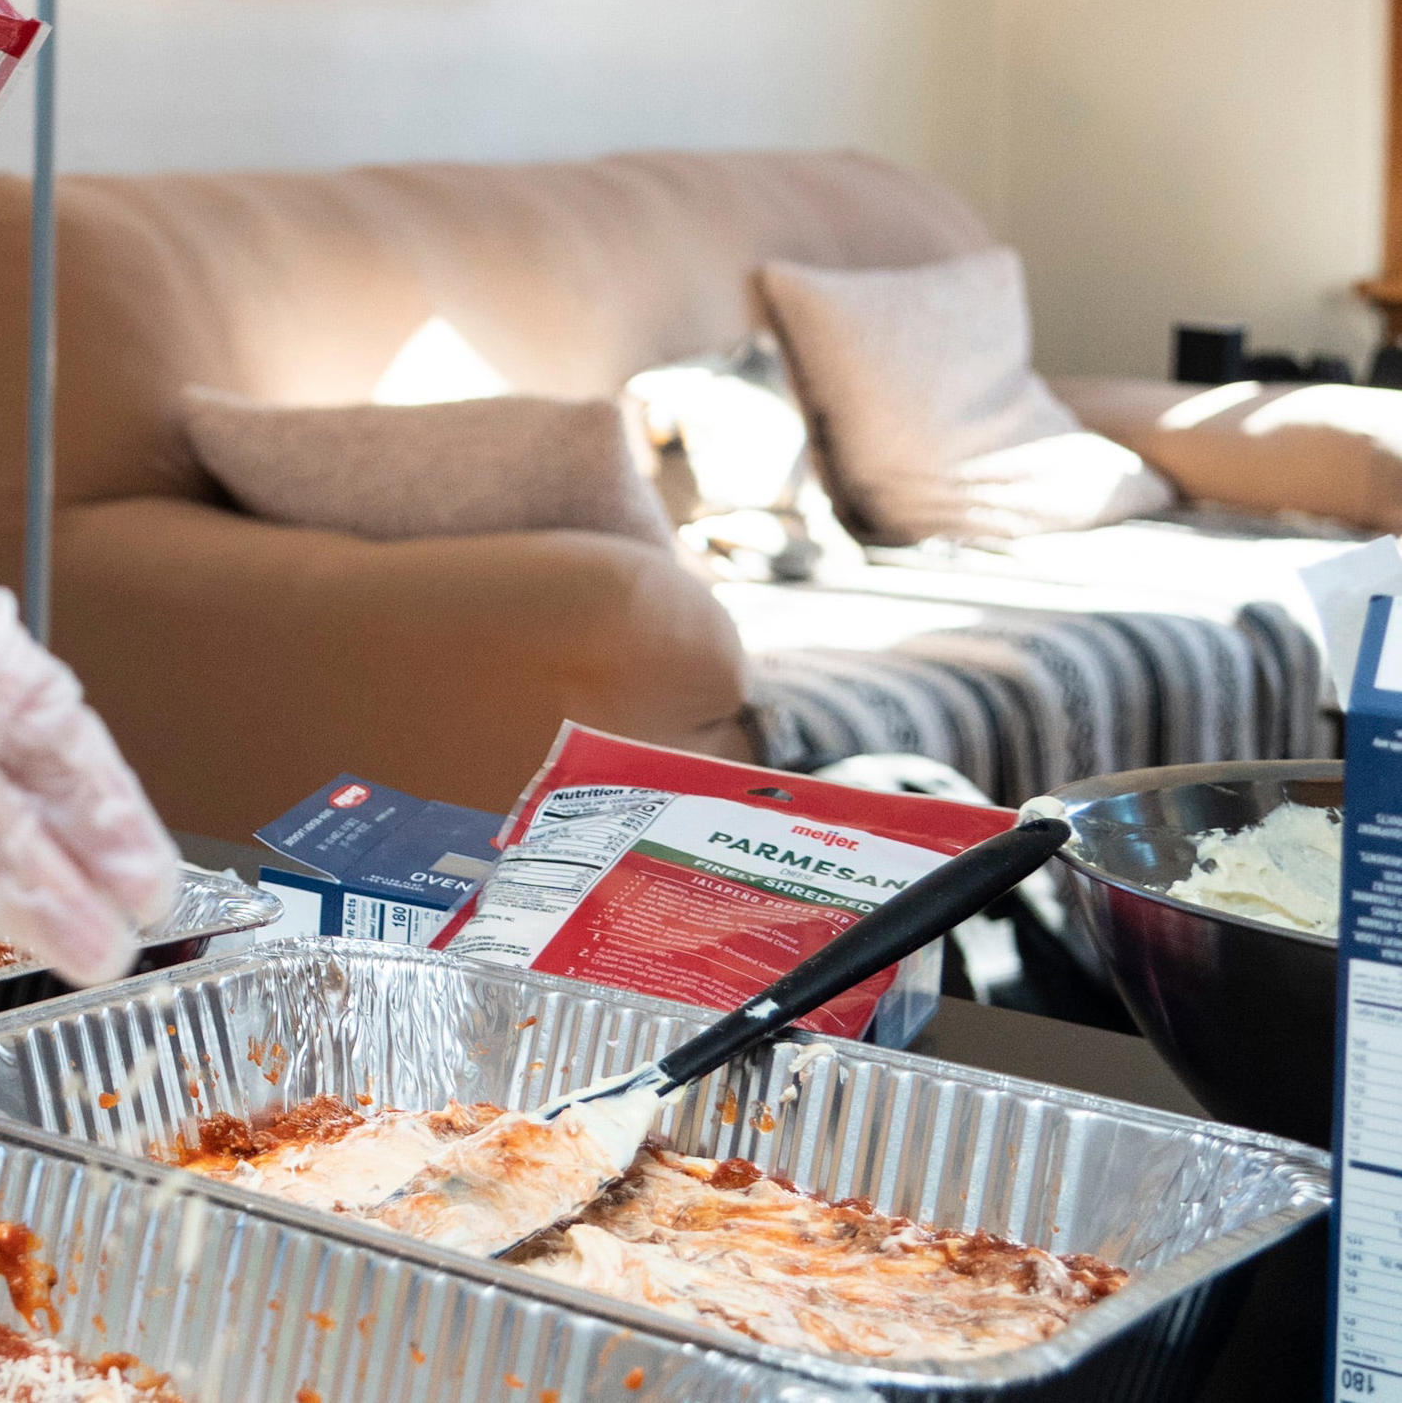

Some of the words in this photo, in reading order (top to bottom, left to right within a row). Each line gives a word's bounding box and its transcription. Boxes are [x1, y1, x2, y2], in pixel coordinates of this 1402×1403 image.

[553, 788, 624, 801] Nutrition
[790, 824, 858, 850] meijer
[707, 831, 910, 890] PARMESAN
[410, 871, 473, 893] OVEN
[693, 859, 763, 883] FINELY
[763, 877, 875, 913] SHREDDED
[392, 905, 407, 928] 180
[763, 900, 820, 916] POPPER
[824, 912, 850, 926] DIP
[1341, 1368, 1374, 1395] 180
